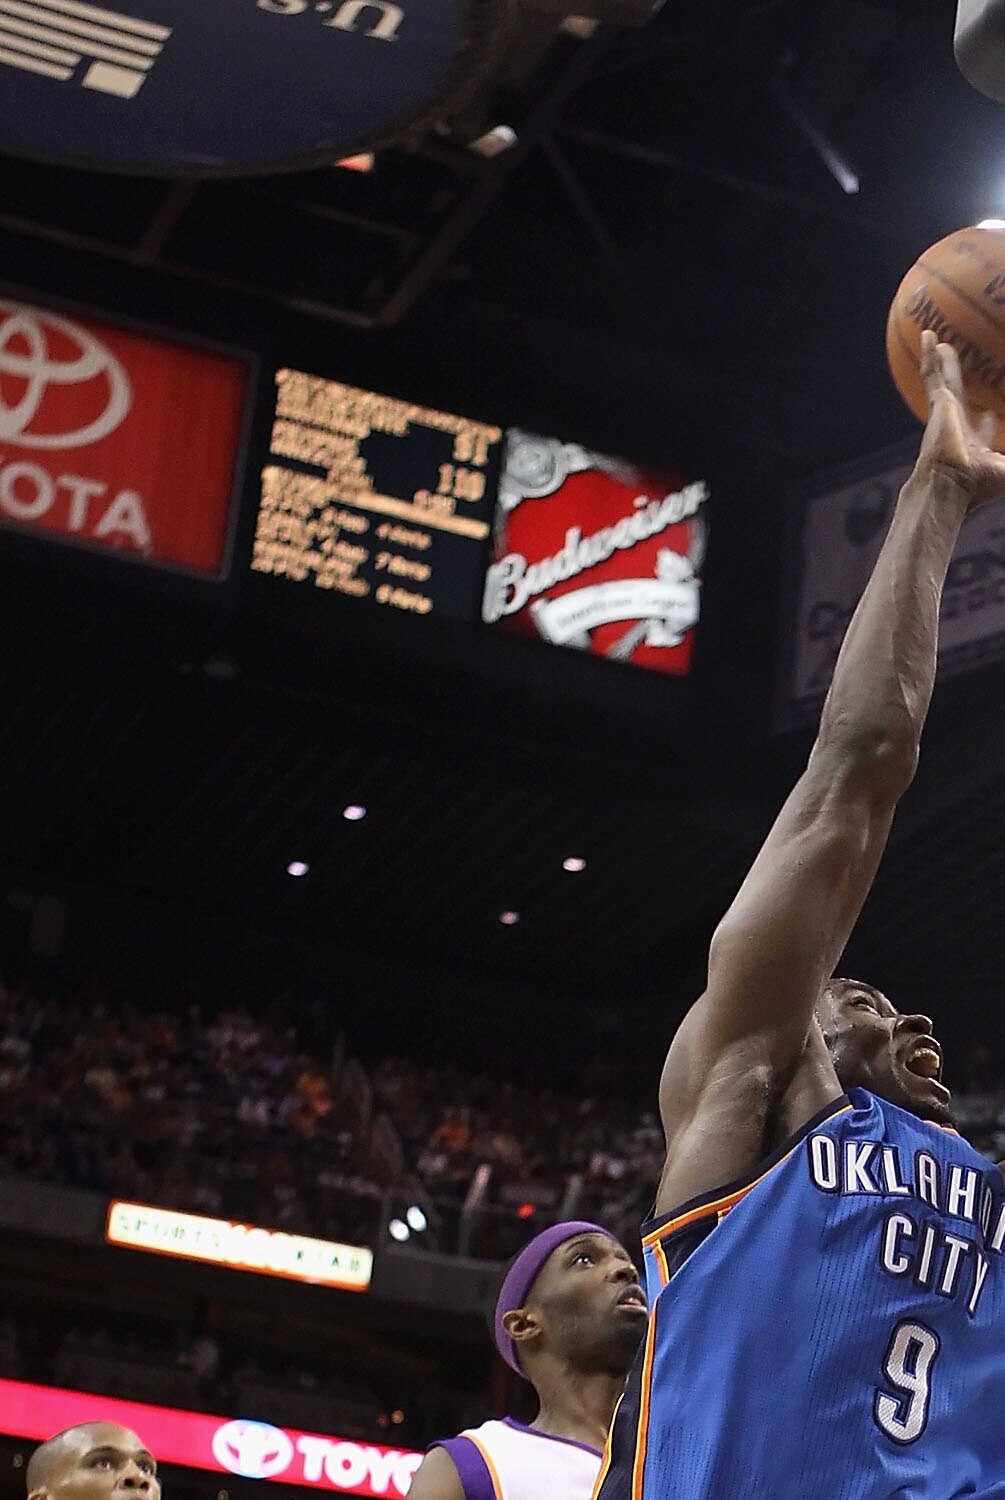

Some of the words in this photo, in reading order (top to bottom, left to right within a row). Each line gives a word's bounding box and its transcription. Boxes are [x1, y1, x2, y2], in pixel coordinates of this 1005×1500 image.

[0, 456, 153, 547] OTA
[481, 479, 710, 624] Budweiser
[883, 1212, 989, 1314] CITY
[876, 1323, 938, 1442] 9
